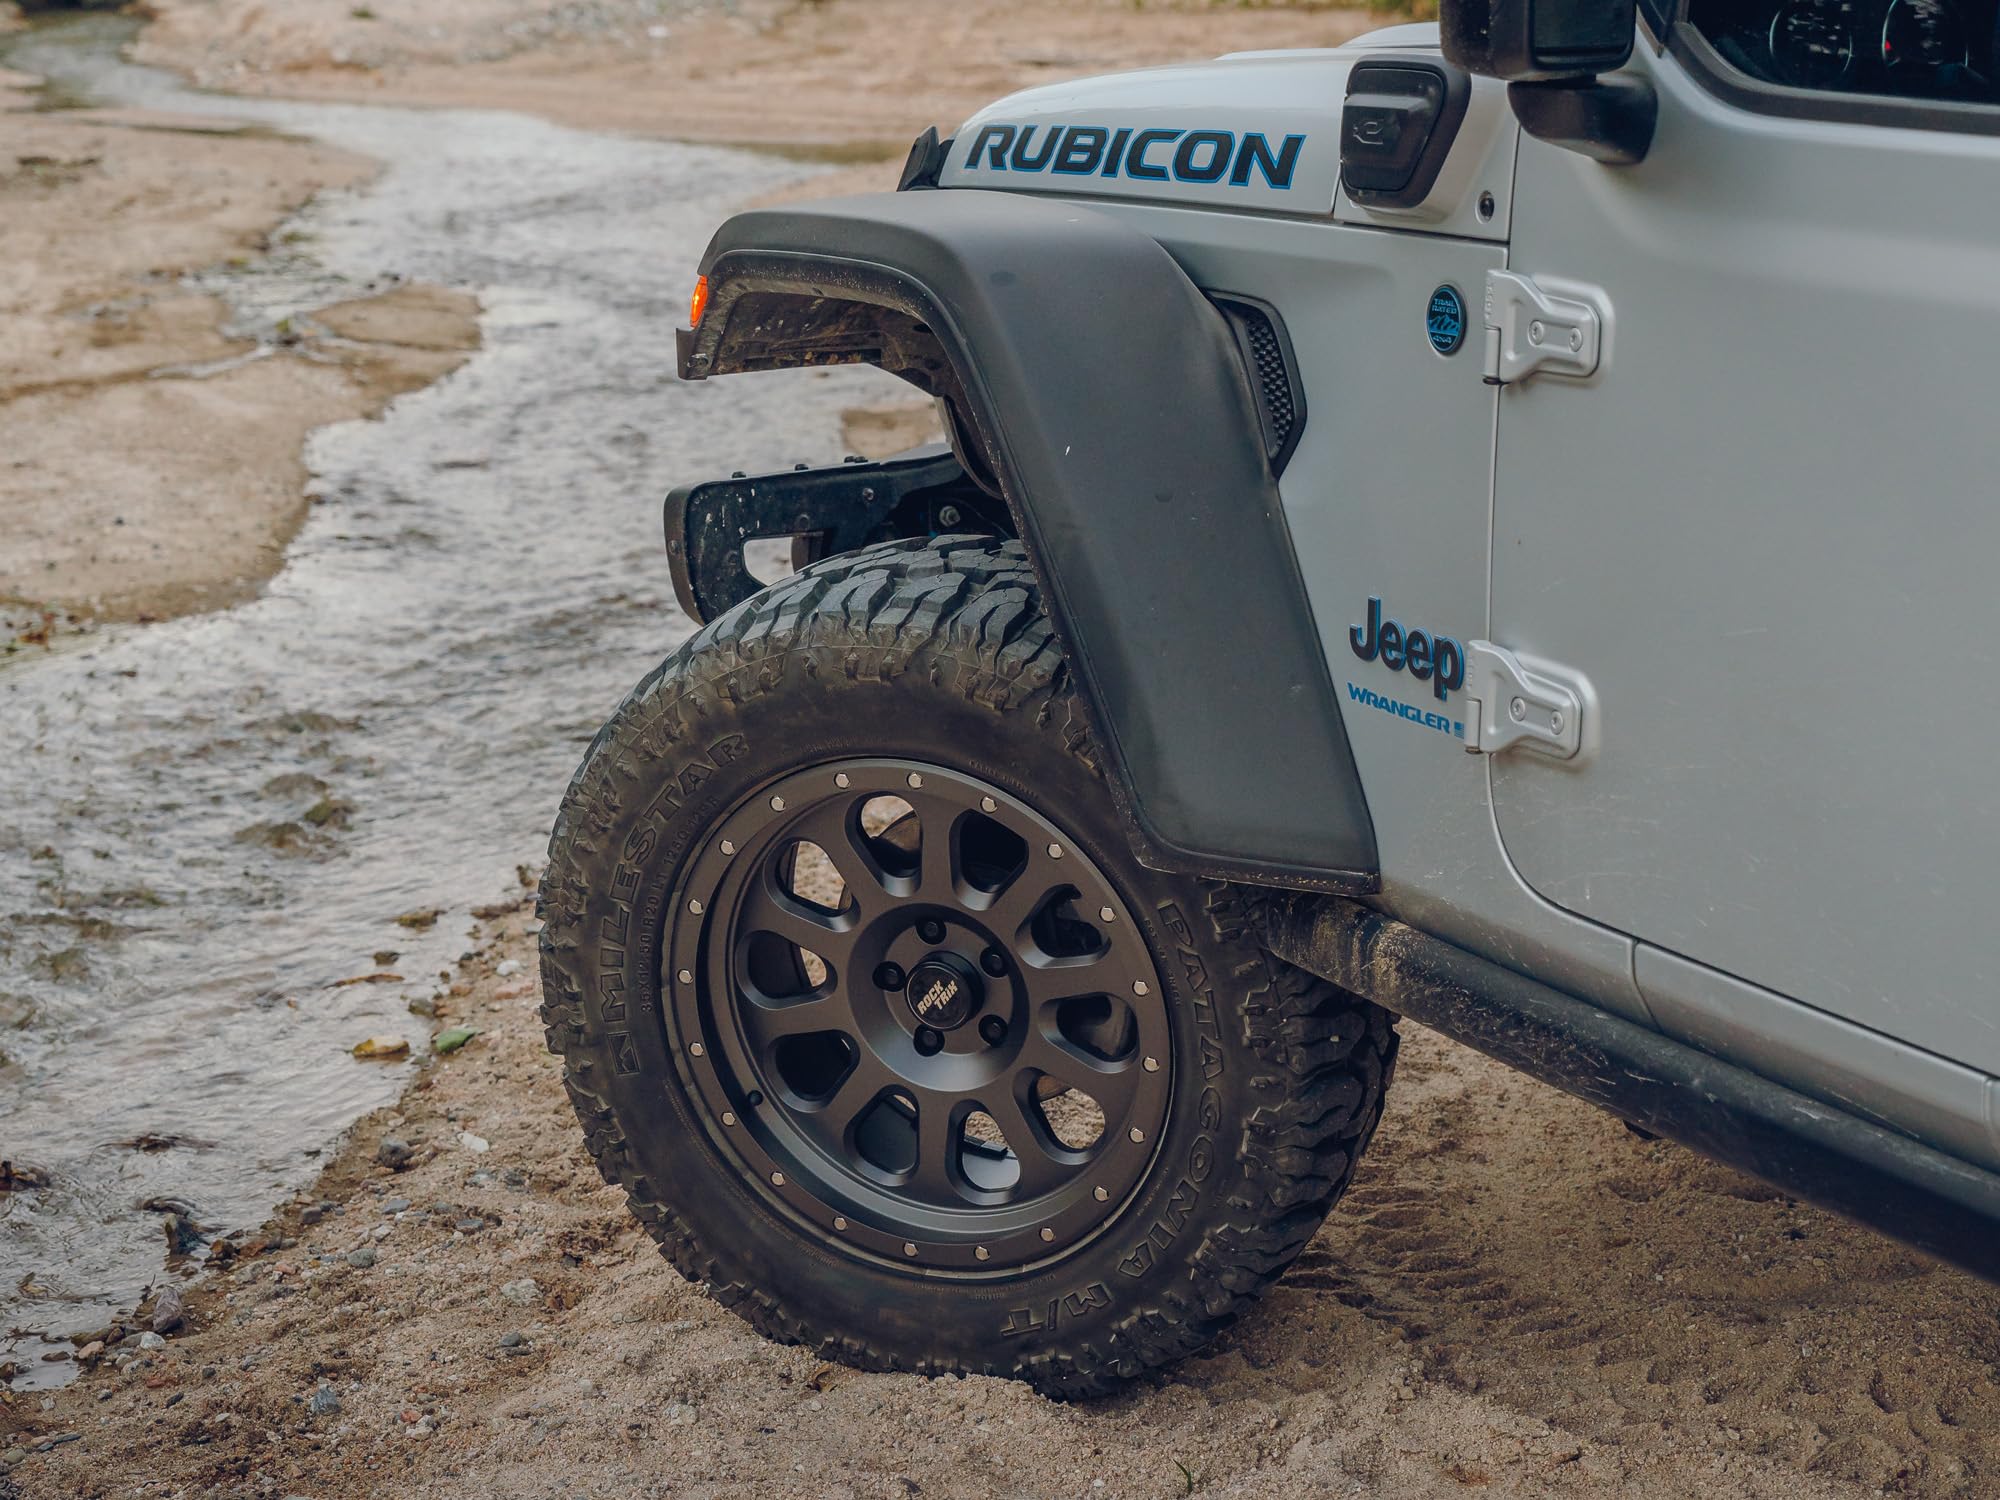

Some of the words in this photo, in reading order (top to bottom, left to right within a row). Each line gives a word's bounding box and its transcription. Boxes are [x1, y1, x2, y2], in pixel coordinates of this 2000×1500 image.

[963, 124, 1307, 190] RUBICON
[1431, 305, 1457, 314] RATED
[1434, 298, 1456, 307] TRAIL
[1349, 594, 1465, 702] Jeep
[1346, 681, 1451, 734] WRANGLER
[600, 733, 749, 1023] MILESTAR
[916, 979, 944, 1015] ROCK
[933, 979, 959, 1011] TRIX
[1117, 900, 1226, 1279] PATAGONIA
[1000, 1282, 1113, 1337] M/T
